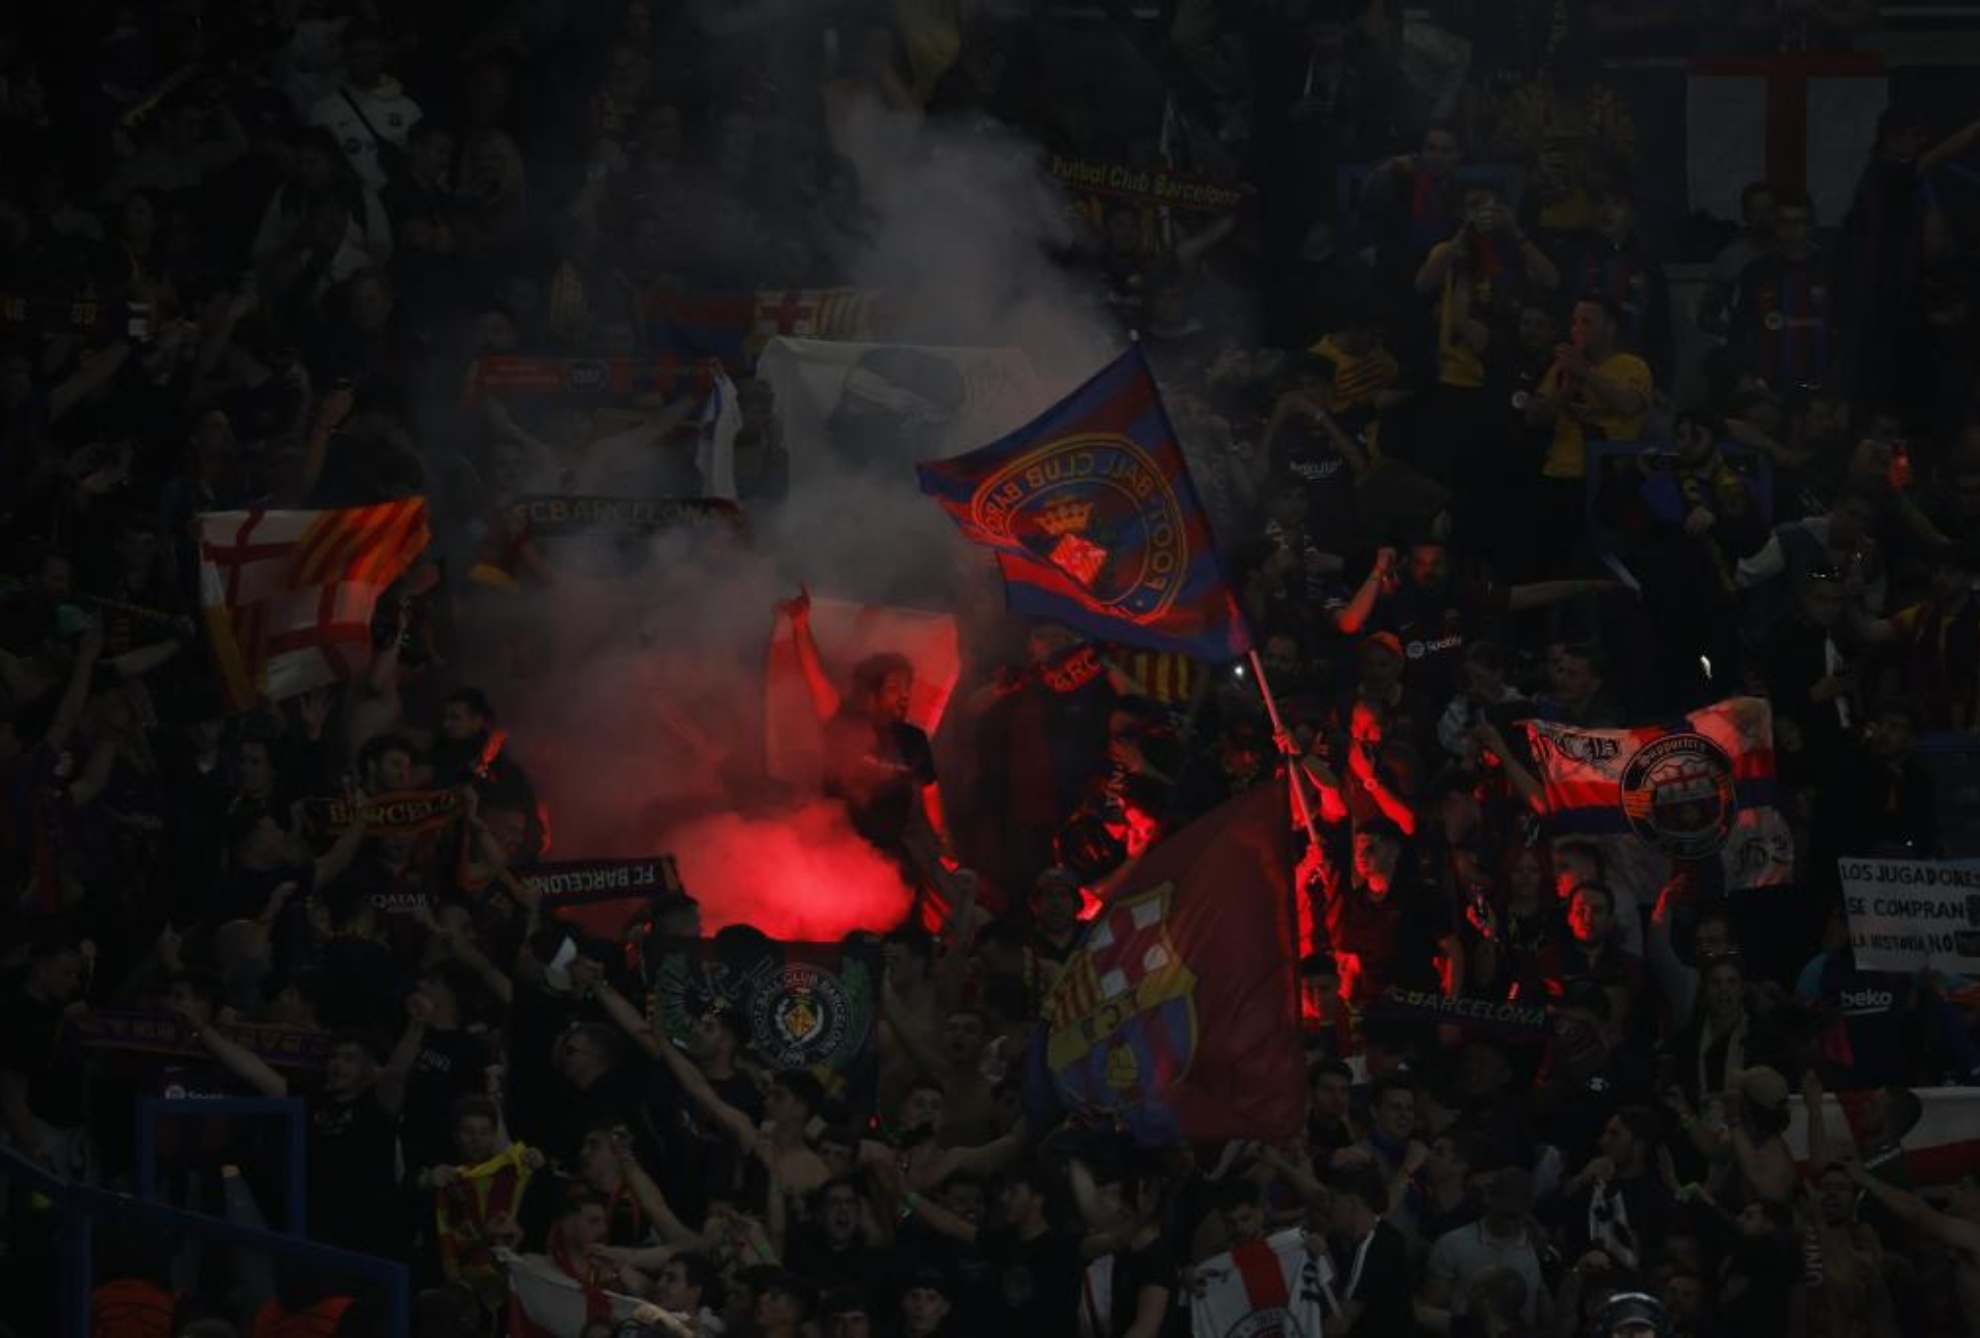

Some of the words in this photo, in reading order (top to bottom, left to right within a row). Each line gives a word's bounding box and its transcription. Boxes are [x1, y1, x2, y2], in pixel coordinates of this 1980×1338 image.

[527, 866, 629, 895] BARCELON
[633, 863, 656, 884] FC
[1841, 862, 1873, 882] LOS
[1873, 897, 1965, 919] COMPRAN
[1928, 933, 1954, 954] NO
[1840, 987, 1894, 1007] beko
